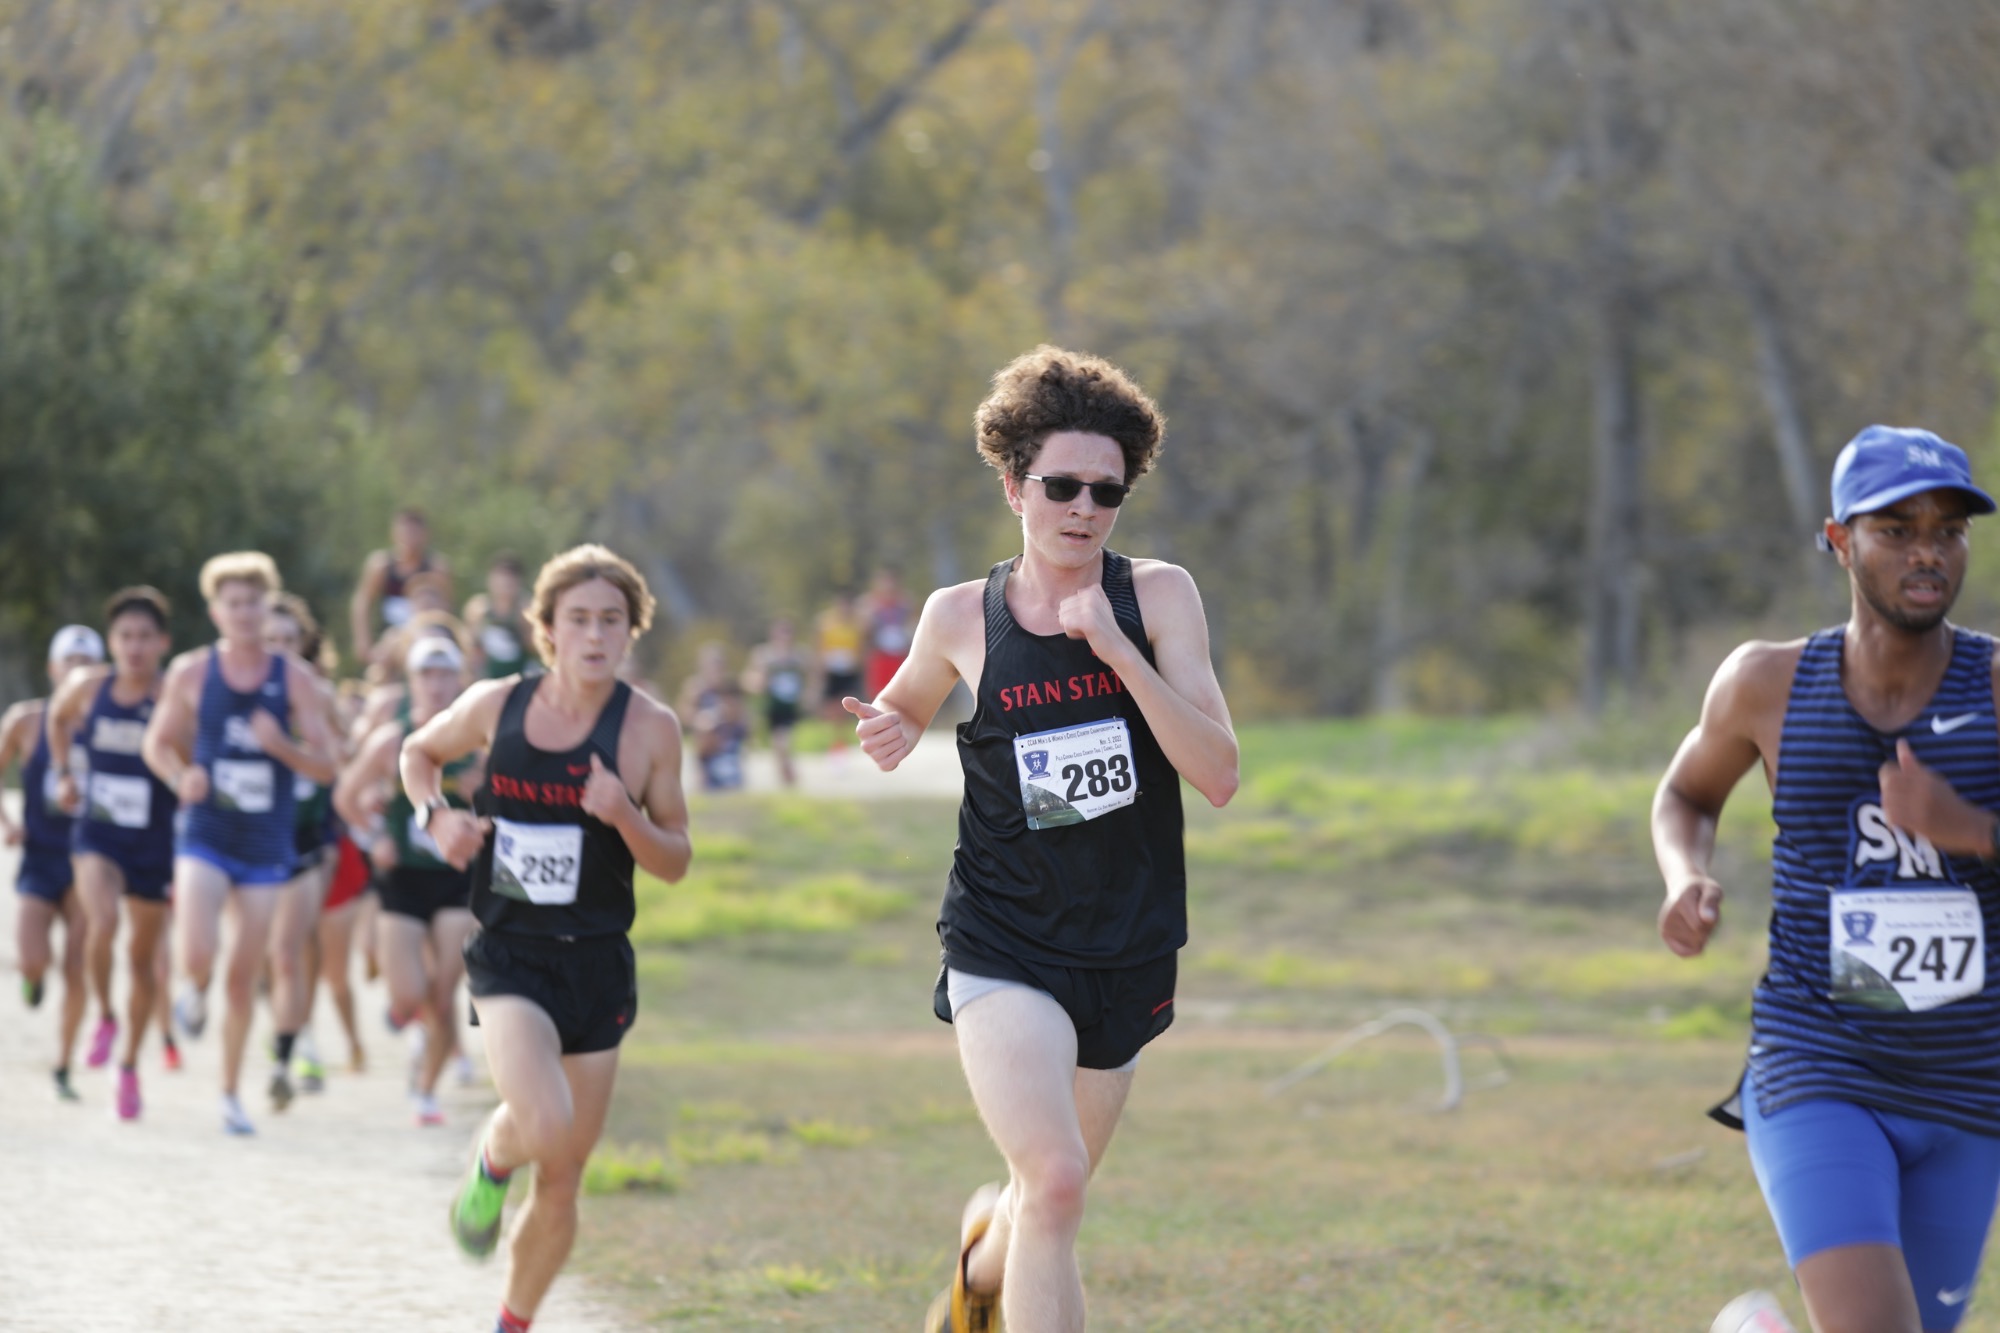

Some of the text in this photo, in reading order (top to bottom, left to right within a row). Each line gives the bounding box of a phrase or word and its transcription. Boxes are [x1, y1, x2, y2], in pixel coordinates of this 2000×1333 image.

[1907, 444, 1942, 468] SM
[1000, 670, 1129, 712] STAN STAT
[491, 773, 538, 803] STAN
[1062, 754, 1132, 803] 283
[521, 854, 576, 886] 282
[1889, 936, 1977, 982] 247
